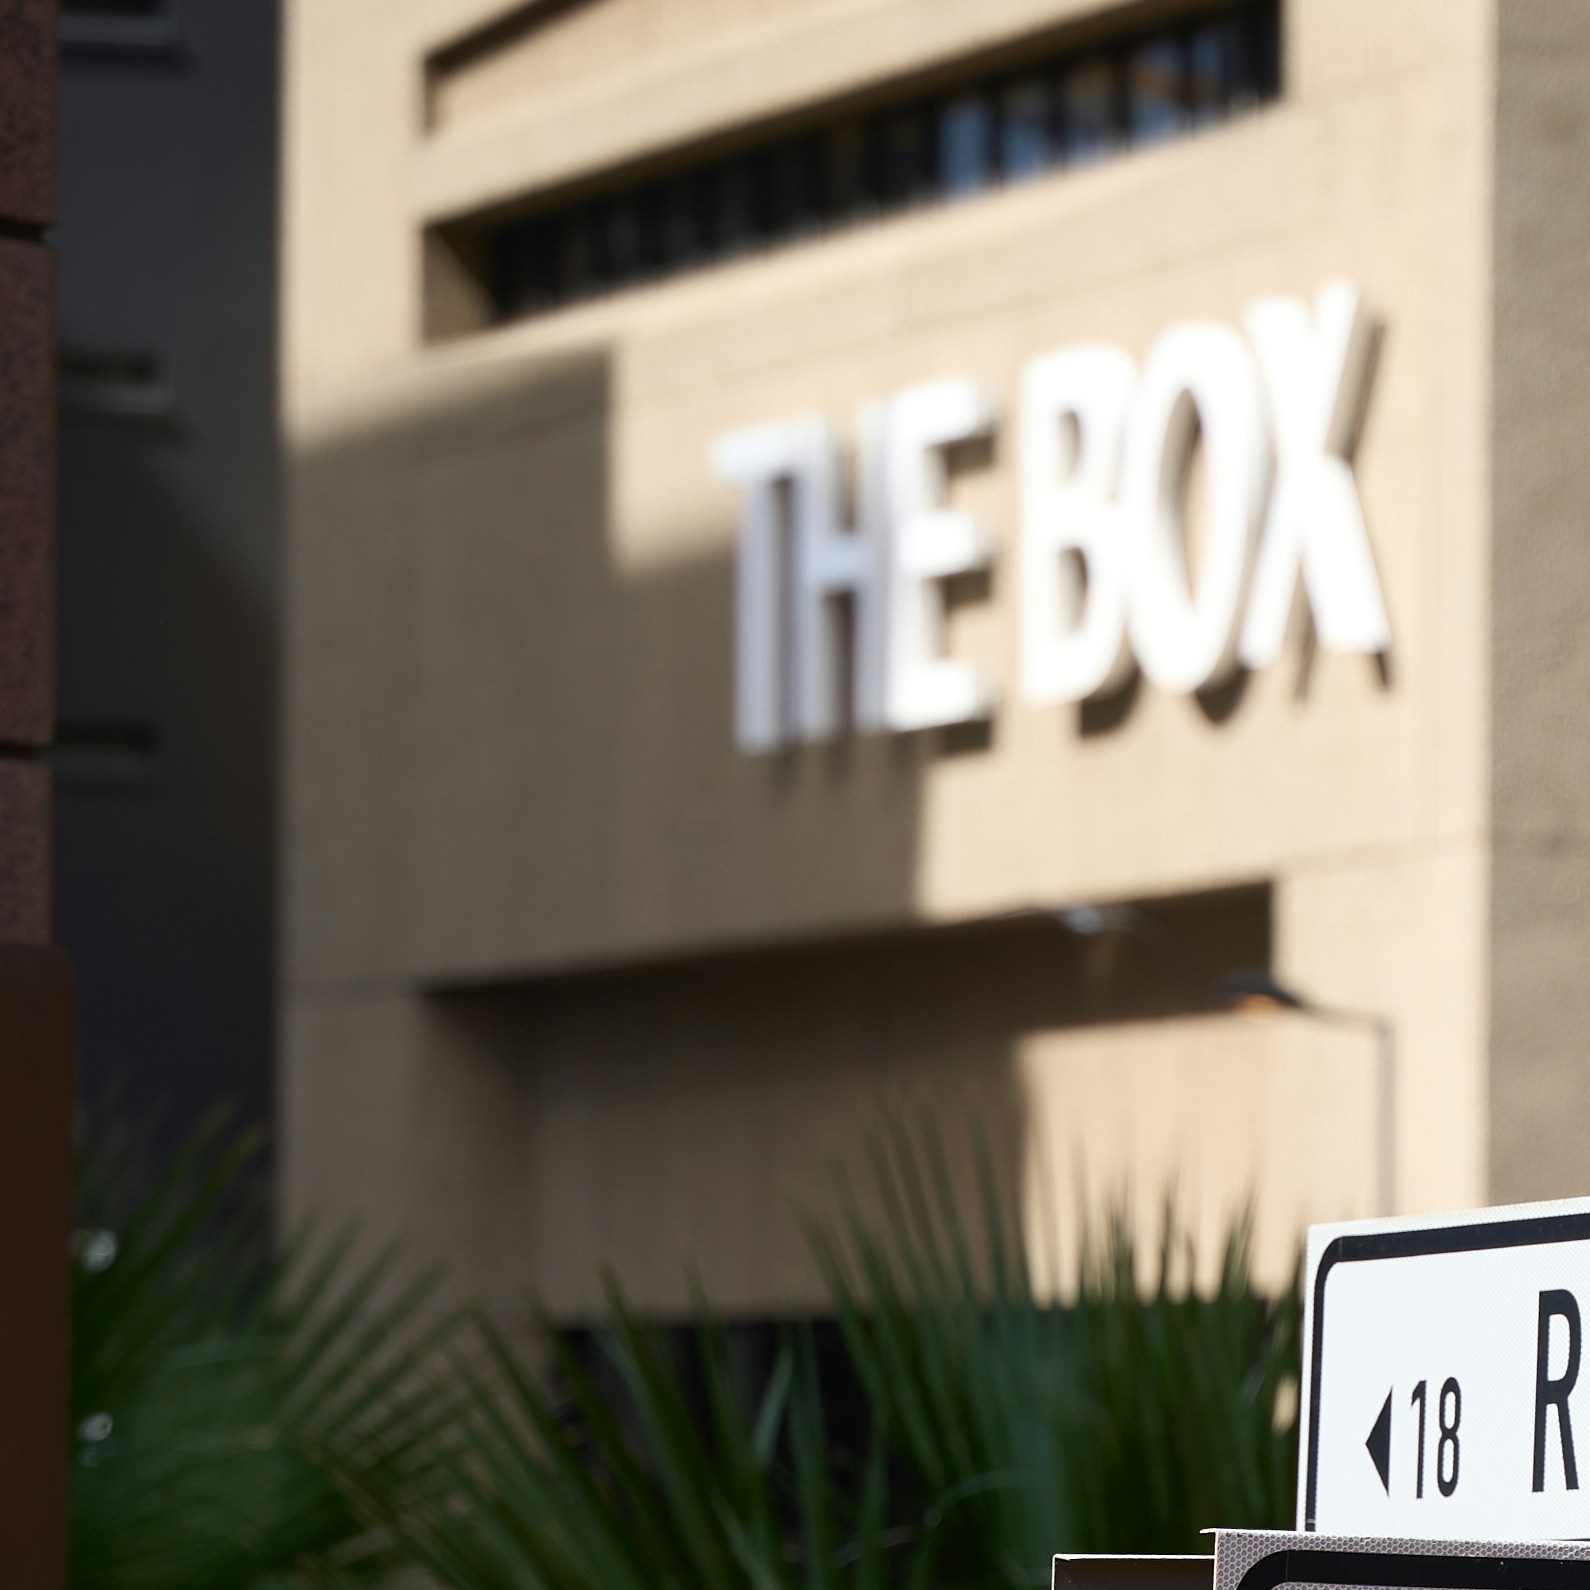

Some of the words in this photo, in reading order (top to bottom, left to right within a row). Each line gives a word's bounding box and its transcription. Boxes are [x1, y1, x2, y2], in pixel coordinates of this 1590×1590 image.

[710, 375, 985, 755] THE
[1018, 279, 1390, 709] BOX
[1411, 1376, 1462, 1499] 18
